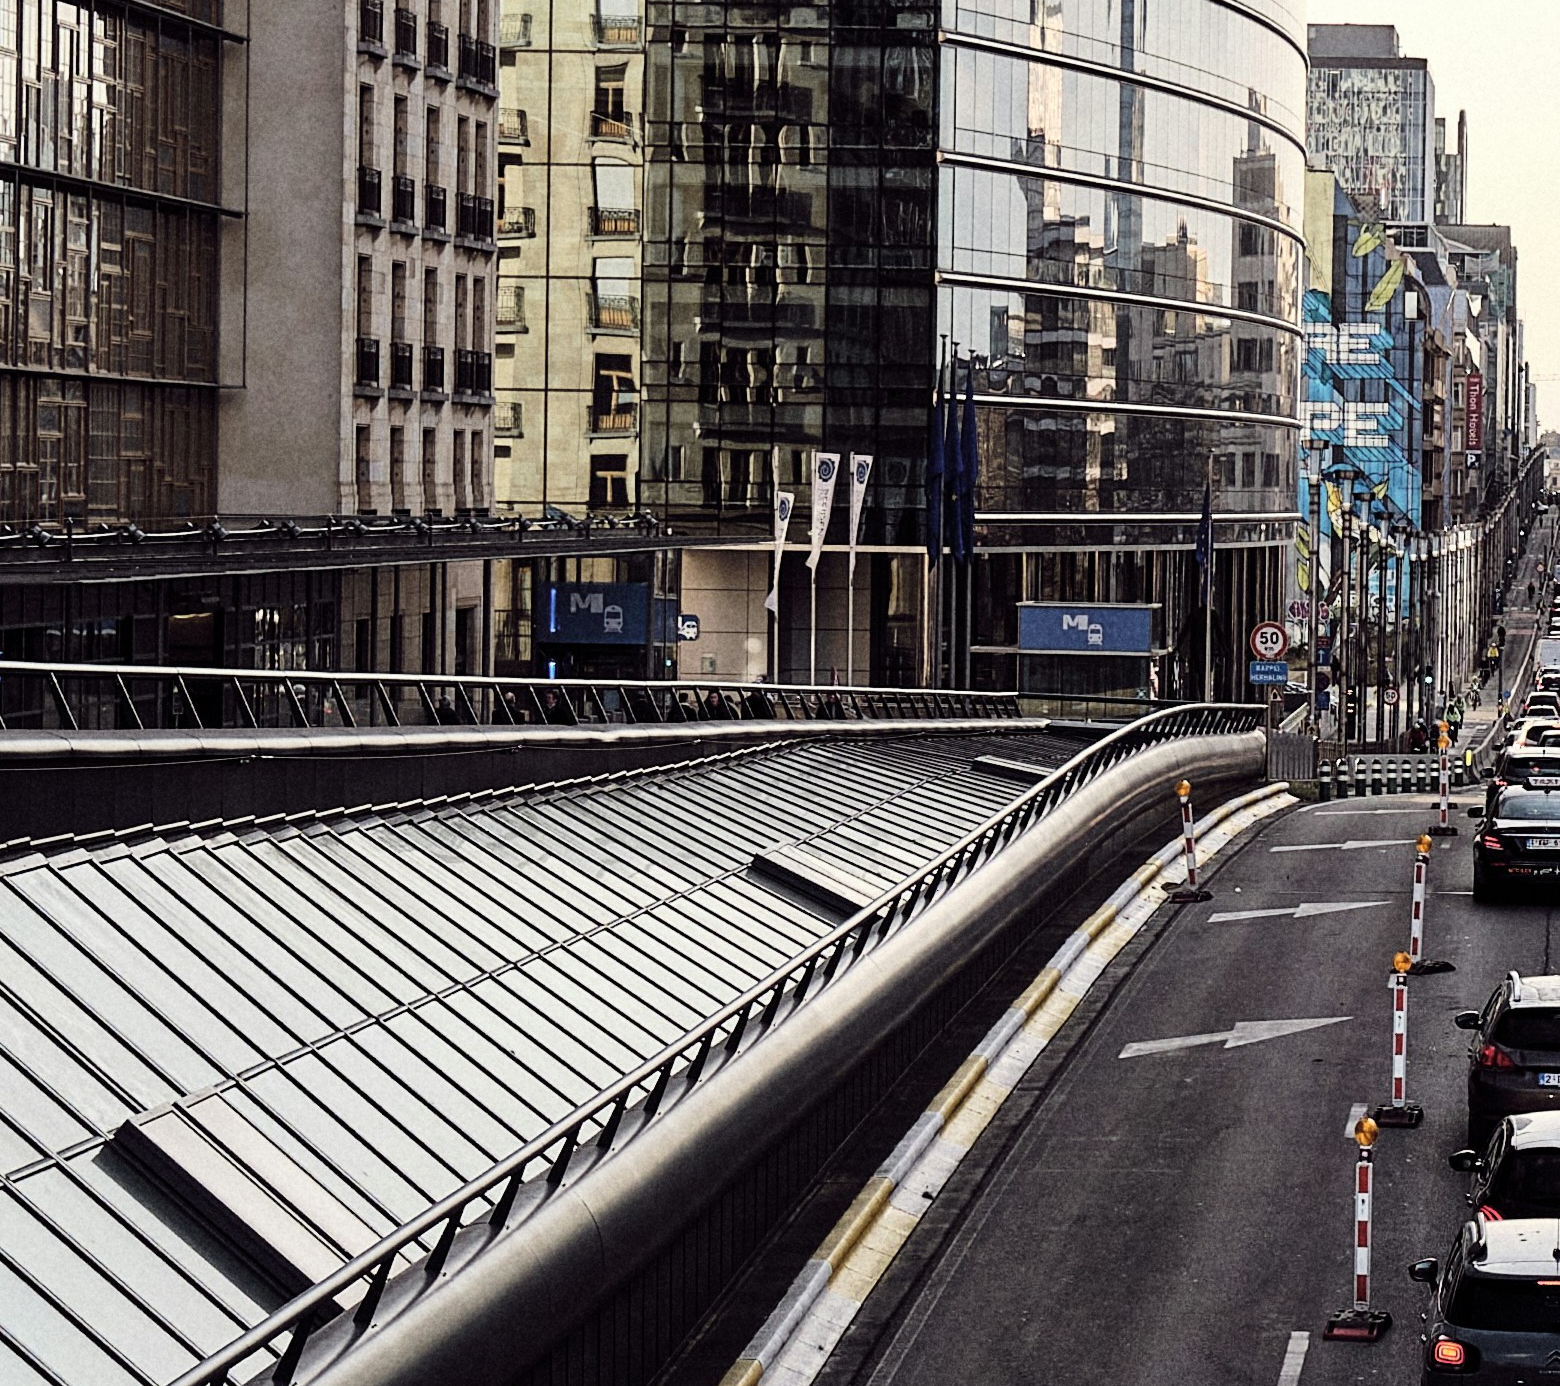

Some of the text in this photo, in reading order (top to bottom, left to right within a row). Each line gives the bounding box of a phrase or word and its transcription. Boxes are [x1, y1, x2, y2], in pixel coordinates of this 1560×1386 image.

[1468, 384, 1480, 446] Thon Hotels
[570, 593, 603, 613] M
[1063, 615, 1088, 630] M
[1259, 631, 1279, 645] 50
